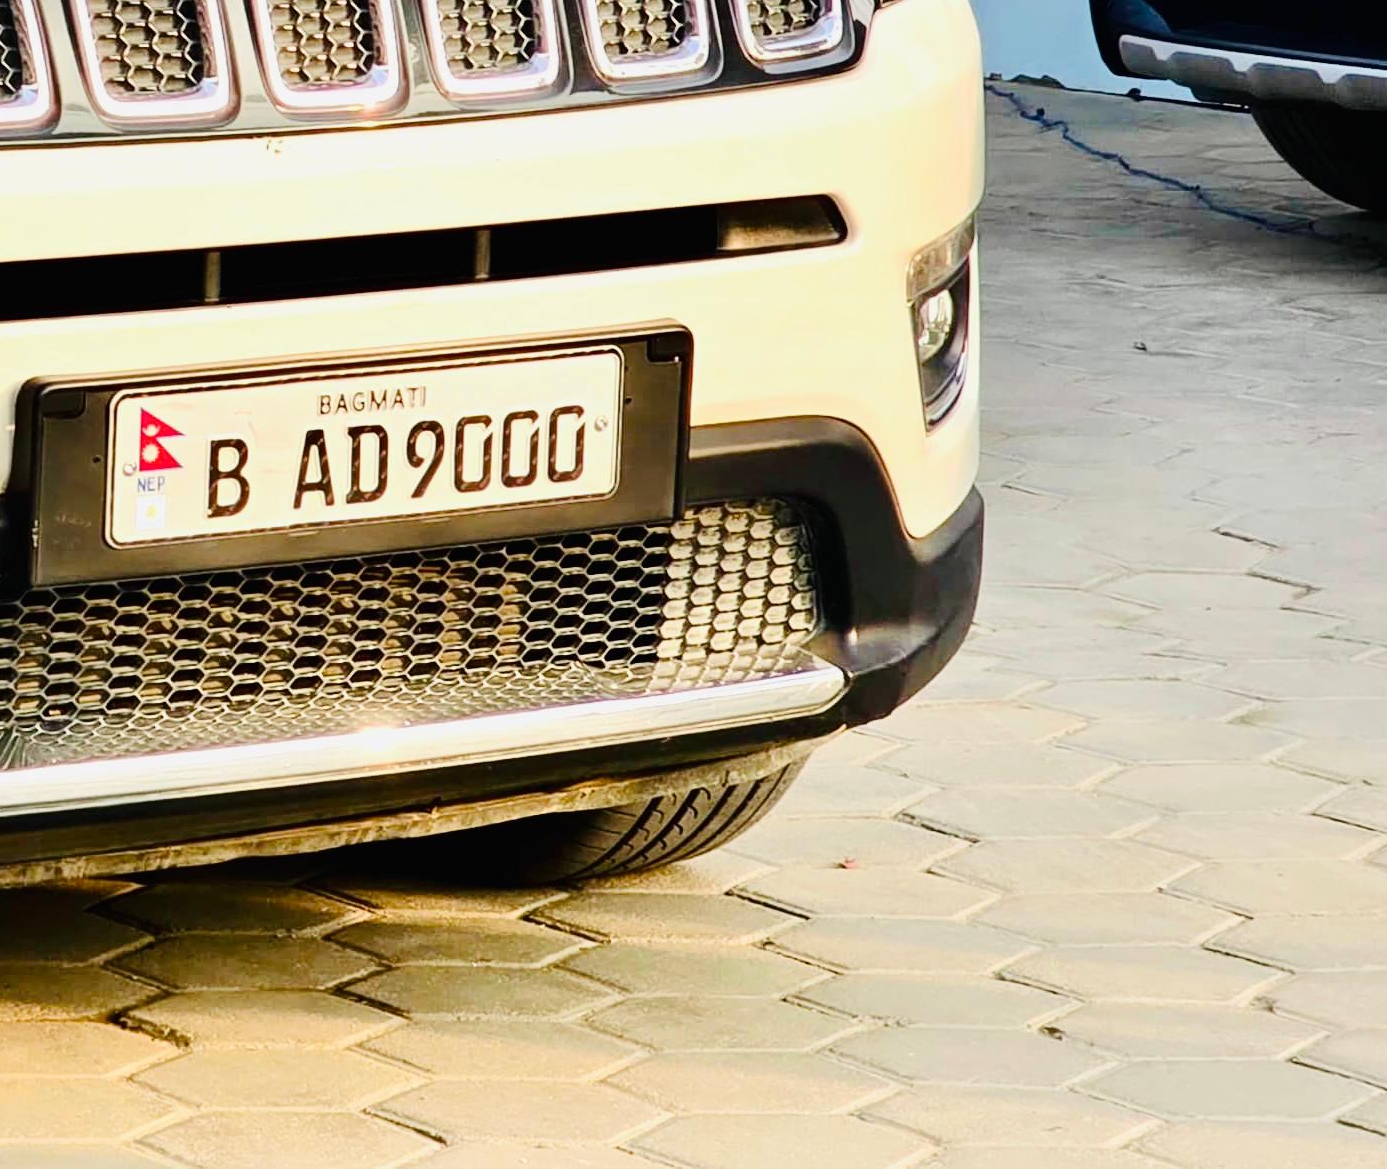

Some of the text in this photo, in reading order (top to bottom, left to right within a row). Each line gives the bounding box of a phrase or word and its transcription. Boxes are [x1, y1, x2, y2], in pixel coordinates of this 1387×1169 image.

[318, 386, 427, 416] BAGMATI
[137, 476, 166, 493] NEP
[207, 438, 251, 519] B
